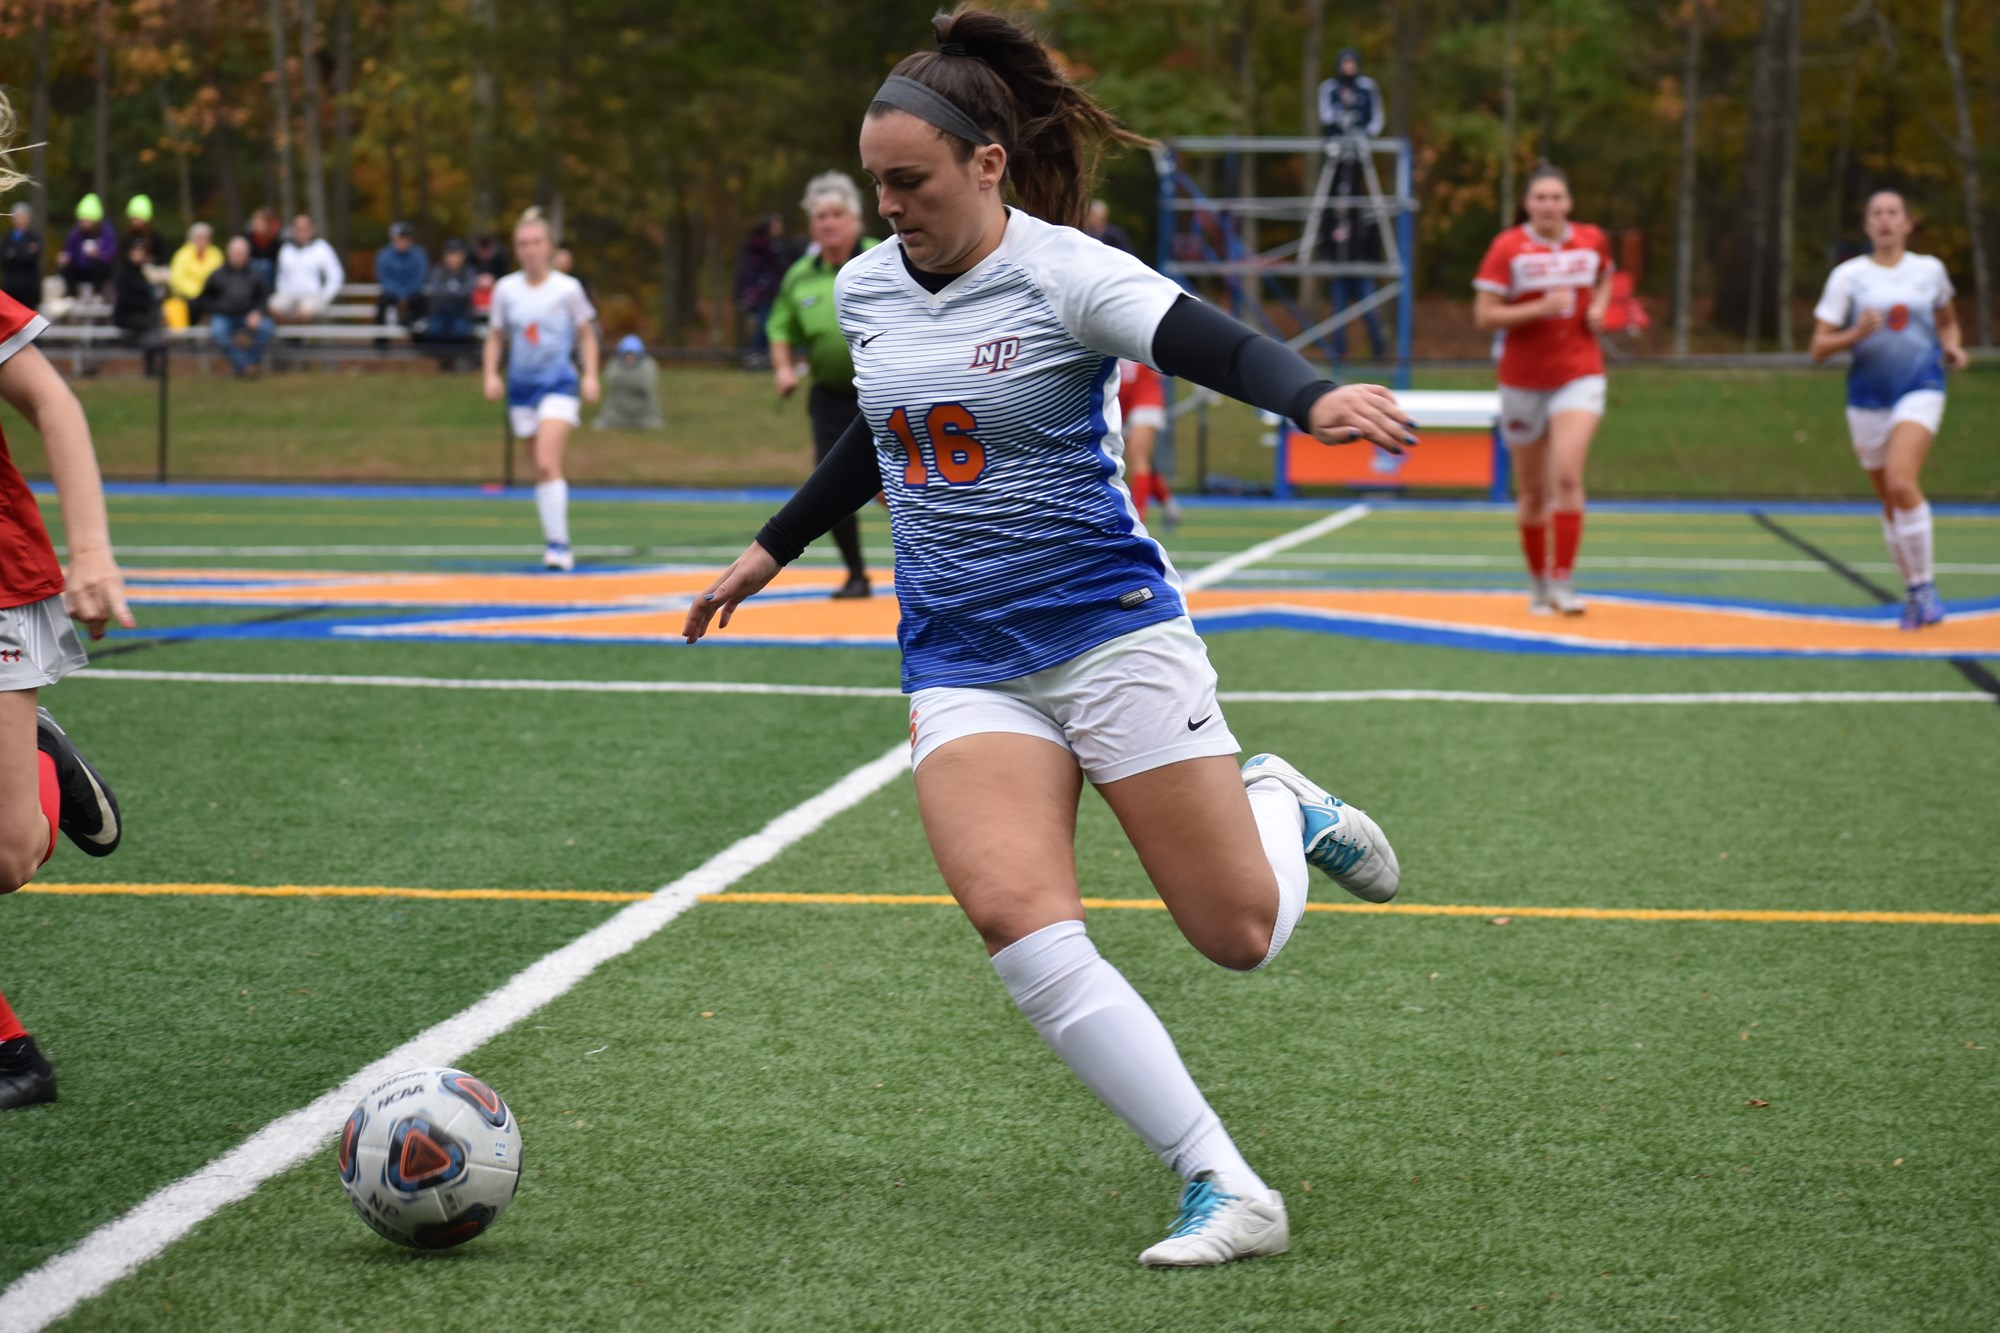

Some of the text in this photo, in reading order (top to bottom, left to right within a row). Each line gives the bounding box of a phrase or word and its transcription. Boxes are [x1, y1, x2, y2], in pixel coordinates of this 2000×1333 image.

[968, 336, 1020, 374] NP
[886, 402, 986, 488] 16
[377, 1083, 425, 1112] NCAA
